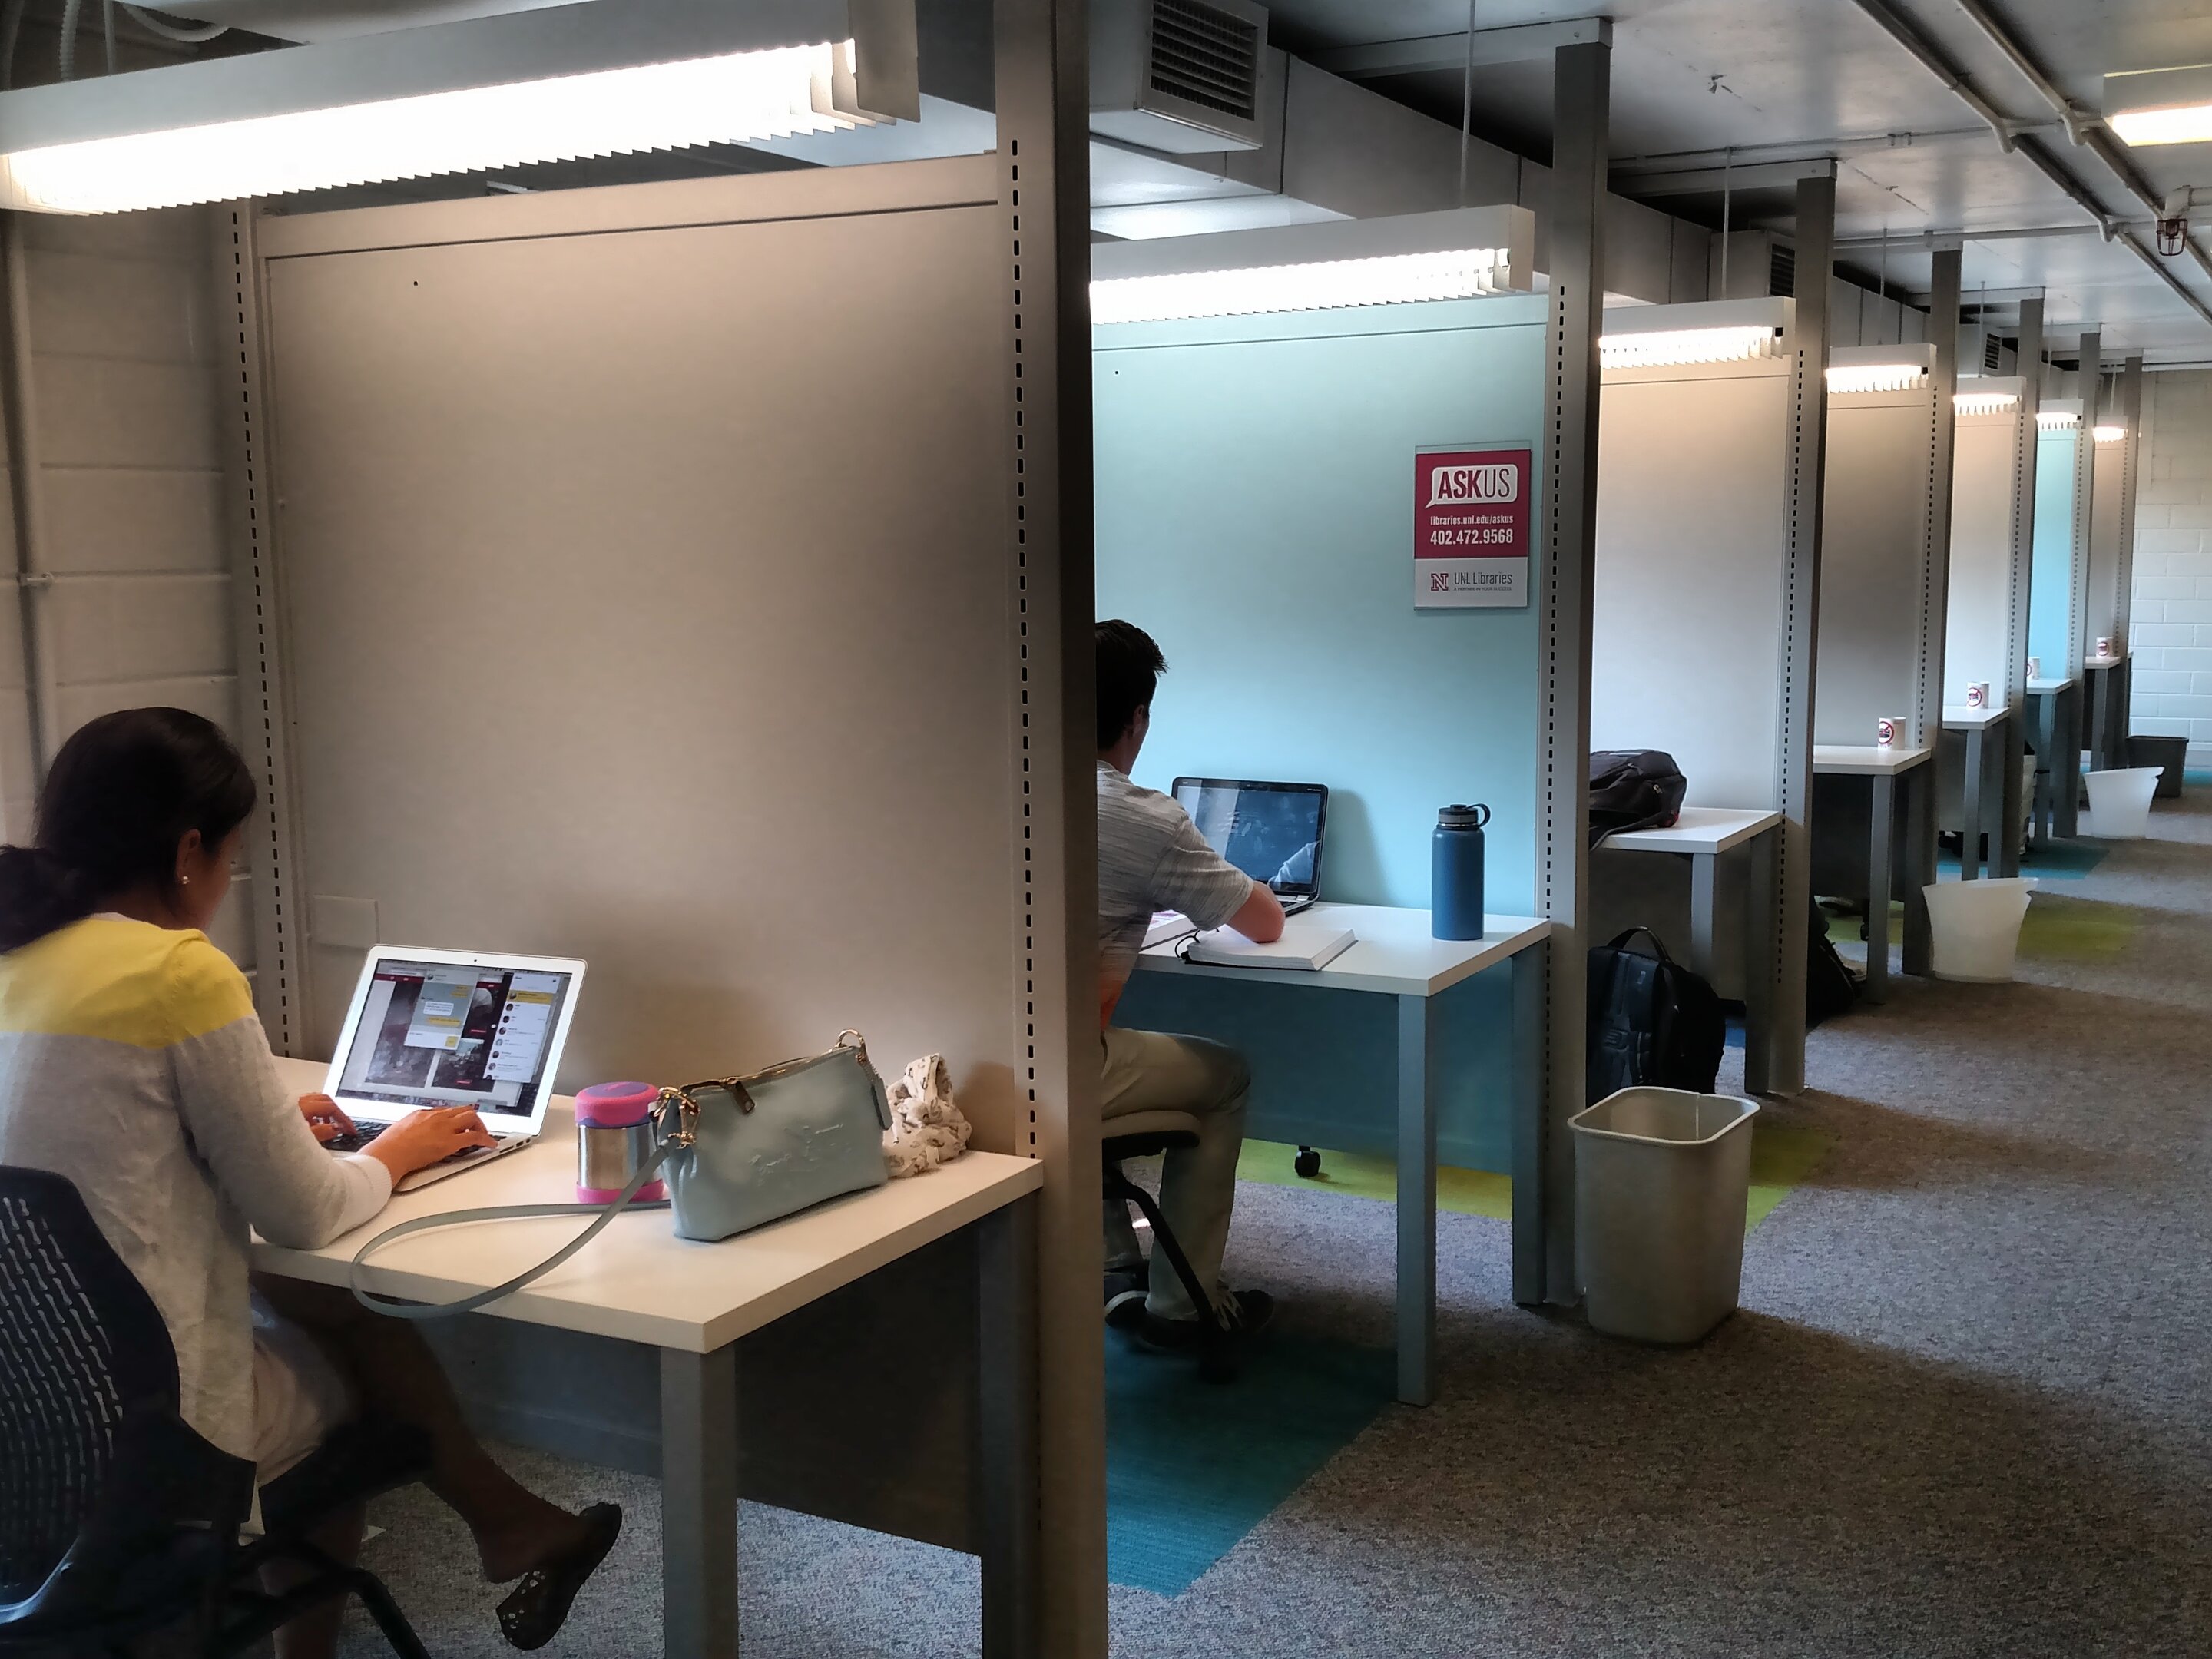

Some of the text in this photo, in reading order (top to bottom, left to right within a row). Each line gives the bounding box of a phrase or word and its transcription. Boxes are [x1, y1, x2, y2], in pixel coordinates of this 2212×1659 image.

[1430, 515, 1513, 525] libraries.unl.edu/askus
[1430, 528, 1513, 545] 402.472.9568
[1431, 573, 1449, 591] N
[1454, 571, 1512, 585] UNL Libraries
